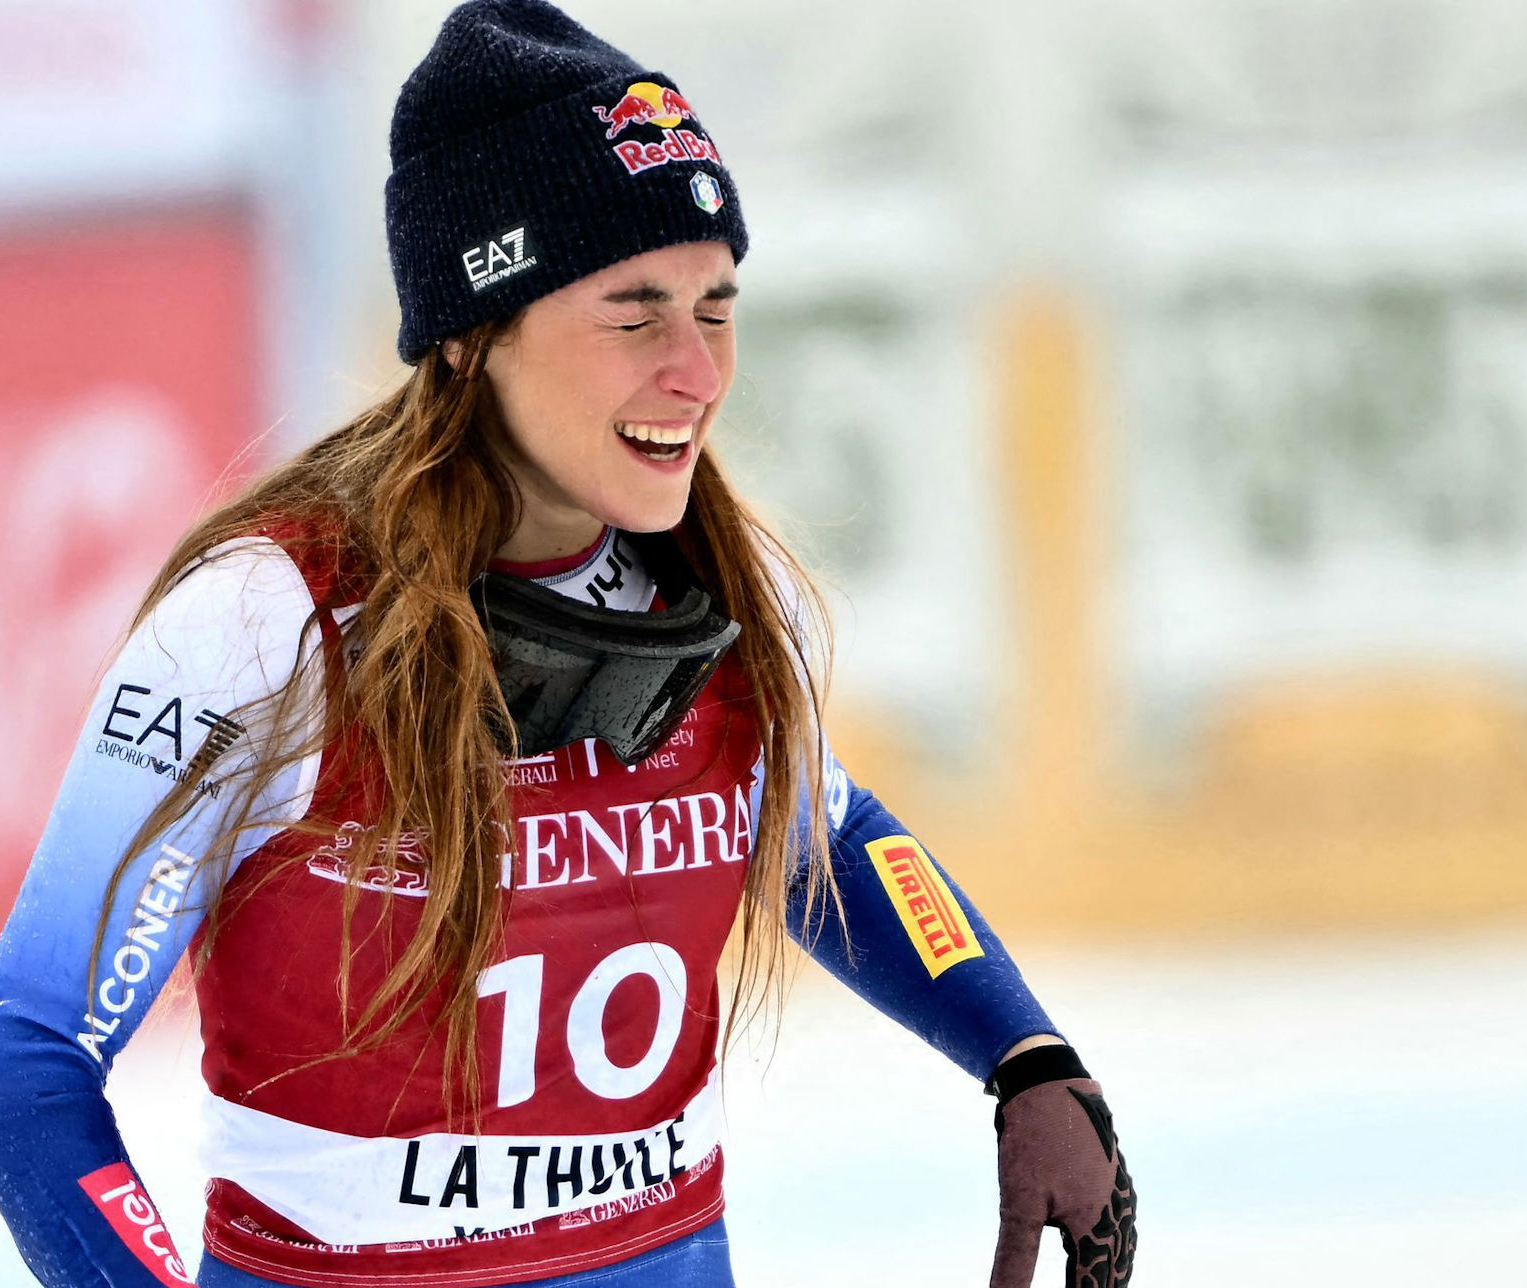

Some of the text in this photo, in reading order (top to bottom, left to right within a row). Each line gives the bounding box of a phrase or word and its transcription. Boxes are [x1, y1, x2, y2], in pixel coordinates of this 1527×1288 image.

[613, 129, 689, 175] Red
[462, 227, 525, 282] EA7
[96, 739, 222, 800] EMPORIO ARANI
[644, 751, 680, 771] Net
[496, 783, 754, 892] ENERA
[882, 846, 968, 959] PIRELLI
[76, 842, 195, 1064] ALCONERI
[478, 941, 688, 1108] 10
[398, 1140, 478, 1209] LA
[589, 1179, 677, 1223] GENERALI
[99, 1178, 196, 1285] enel
